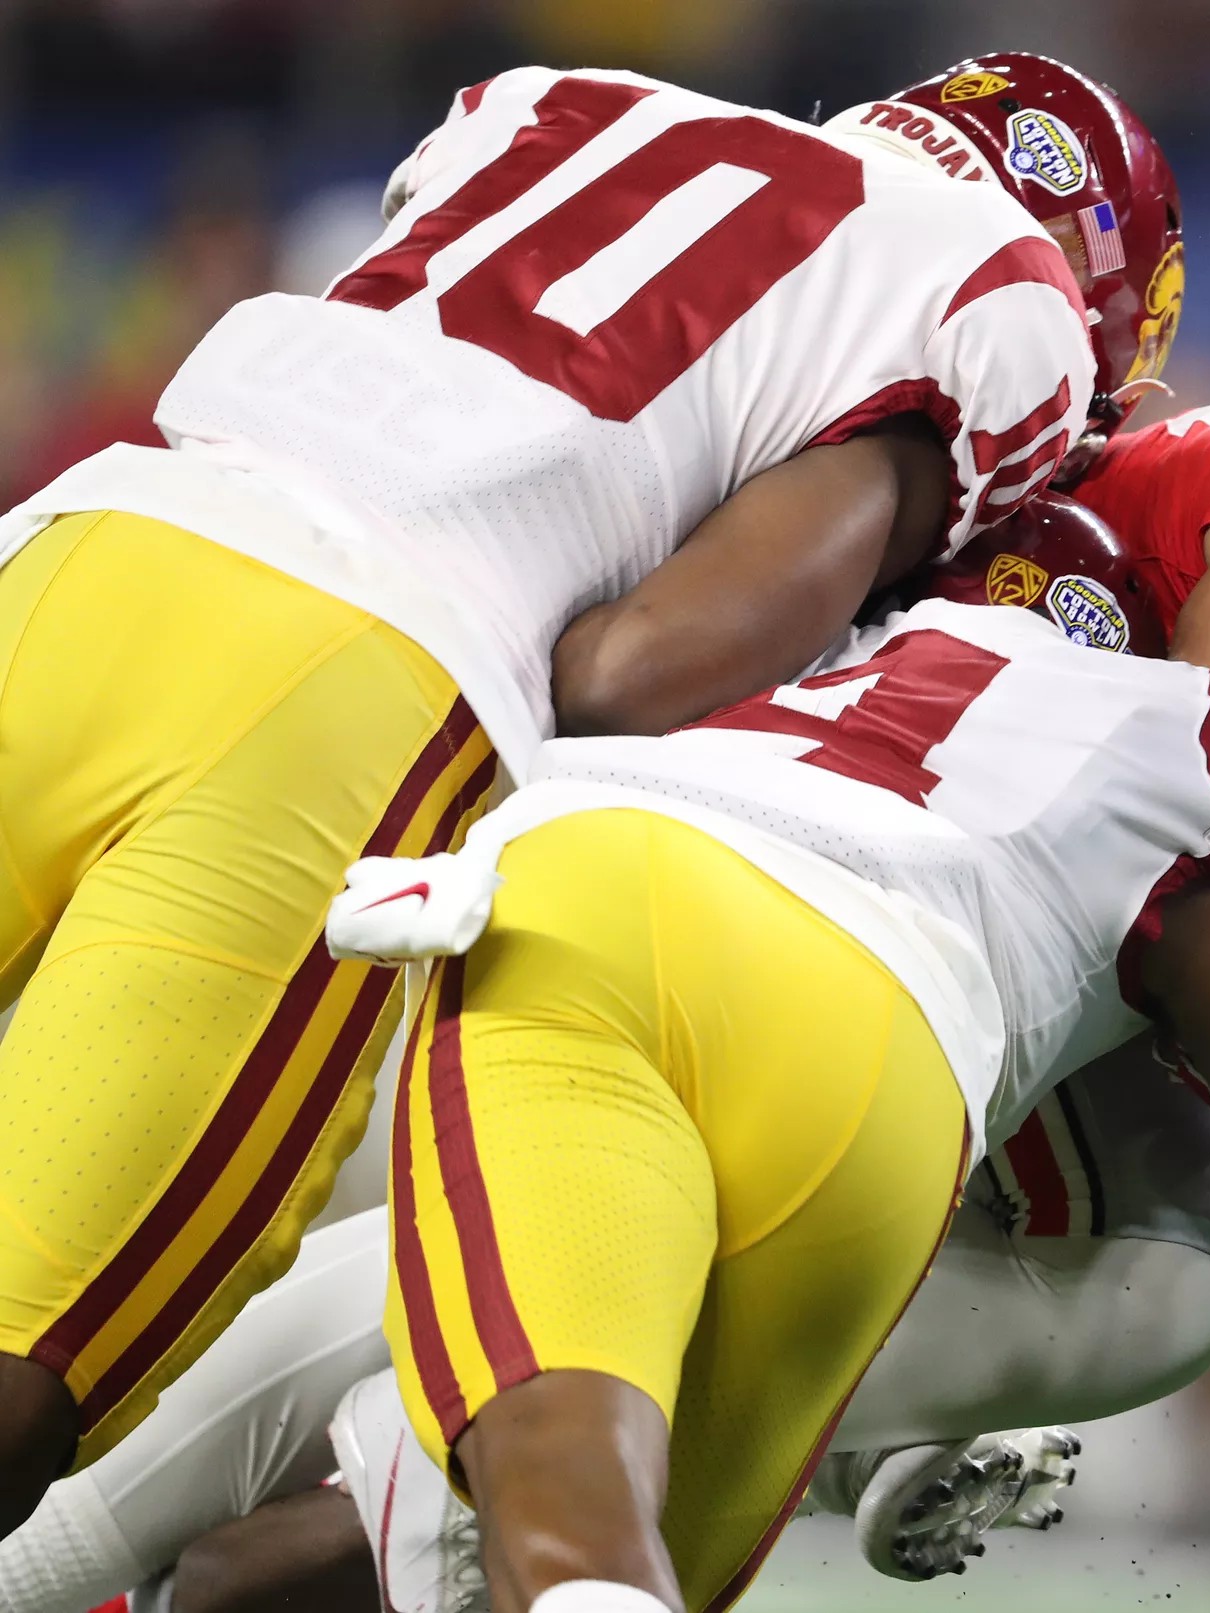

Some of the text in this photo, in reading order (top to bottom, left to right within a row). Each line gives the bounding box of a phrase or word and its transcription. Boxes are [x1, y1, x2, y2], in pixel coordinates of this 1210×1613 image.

[1018, 117, 1076, 185] COTTON
[325, 77, 866, 423] 10
[991, 557, 1045, 602] PAC
[992, 581, 1026, 606] 12
[1058, 587, 1122, 648] COTTON
[1066, 606, 1107, 644] BOWL
[1067, 580, 1125, 629] GOODYEAR
